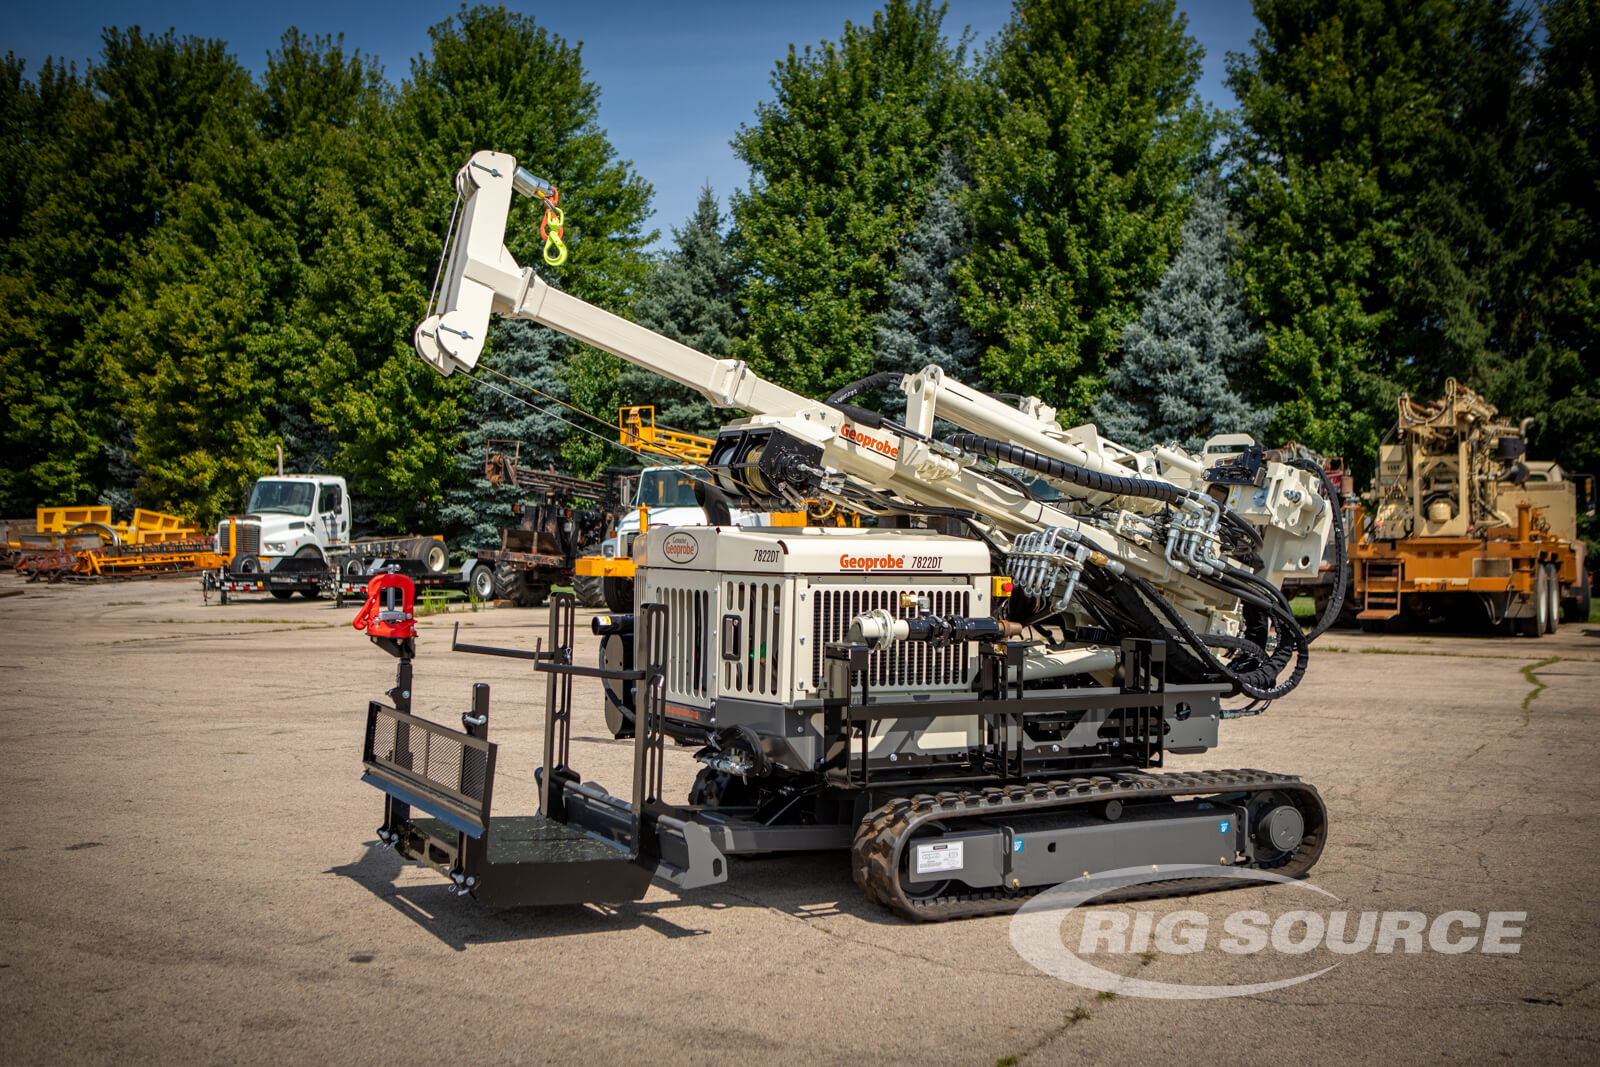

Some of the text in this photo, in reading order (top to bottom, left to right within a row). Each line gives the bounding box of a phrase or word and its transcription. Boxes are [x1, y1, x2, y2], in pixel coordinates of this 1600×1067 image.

[841, 424, 899, 458] Geoprobe
[753, 549, 780, 563] 7822DT
[911, 556, 943, 569] 7822DT
